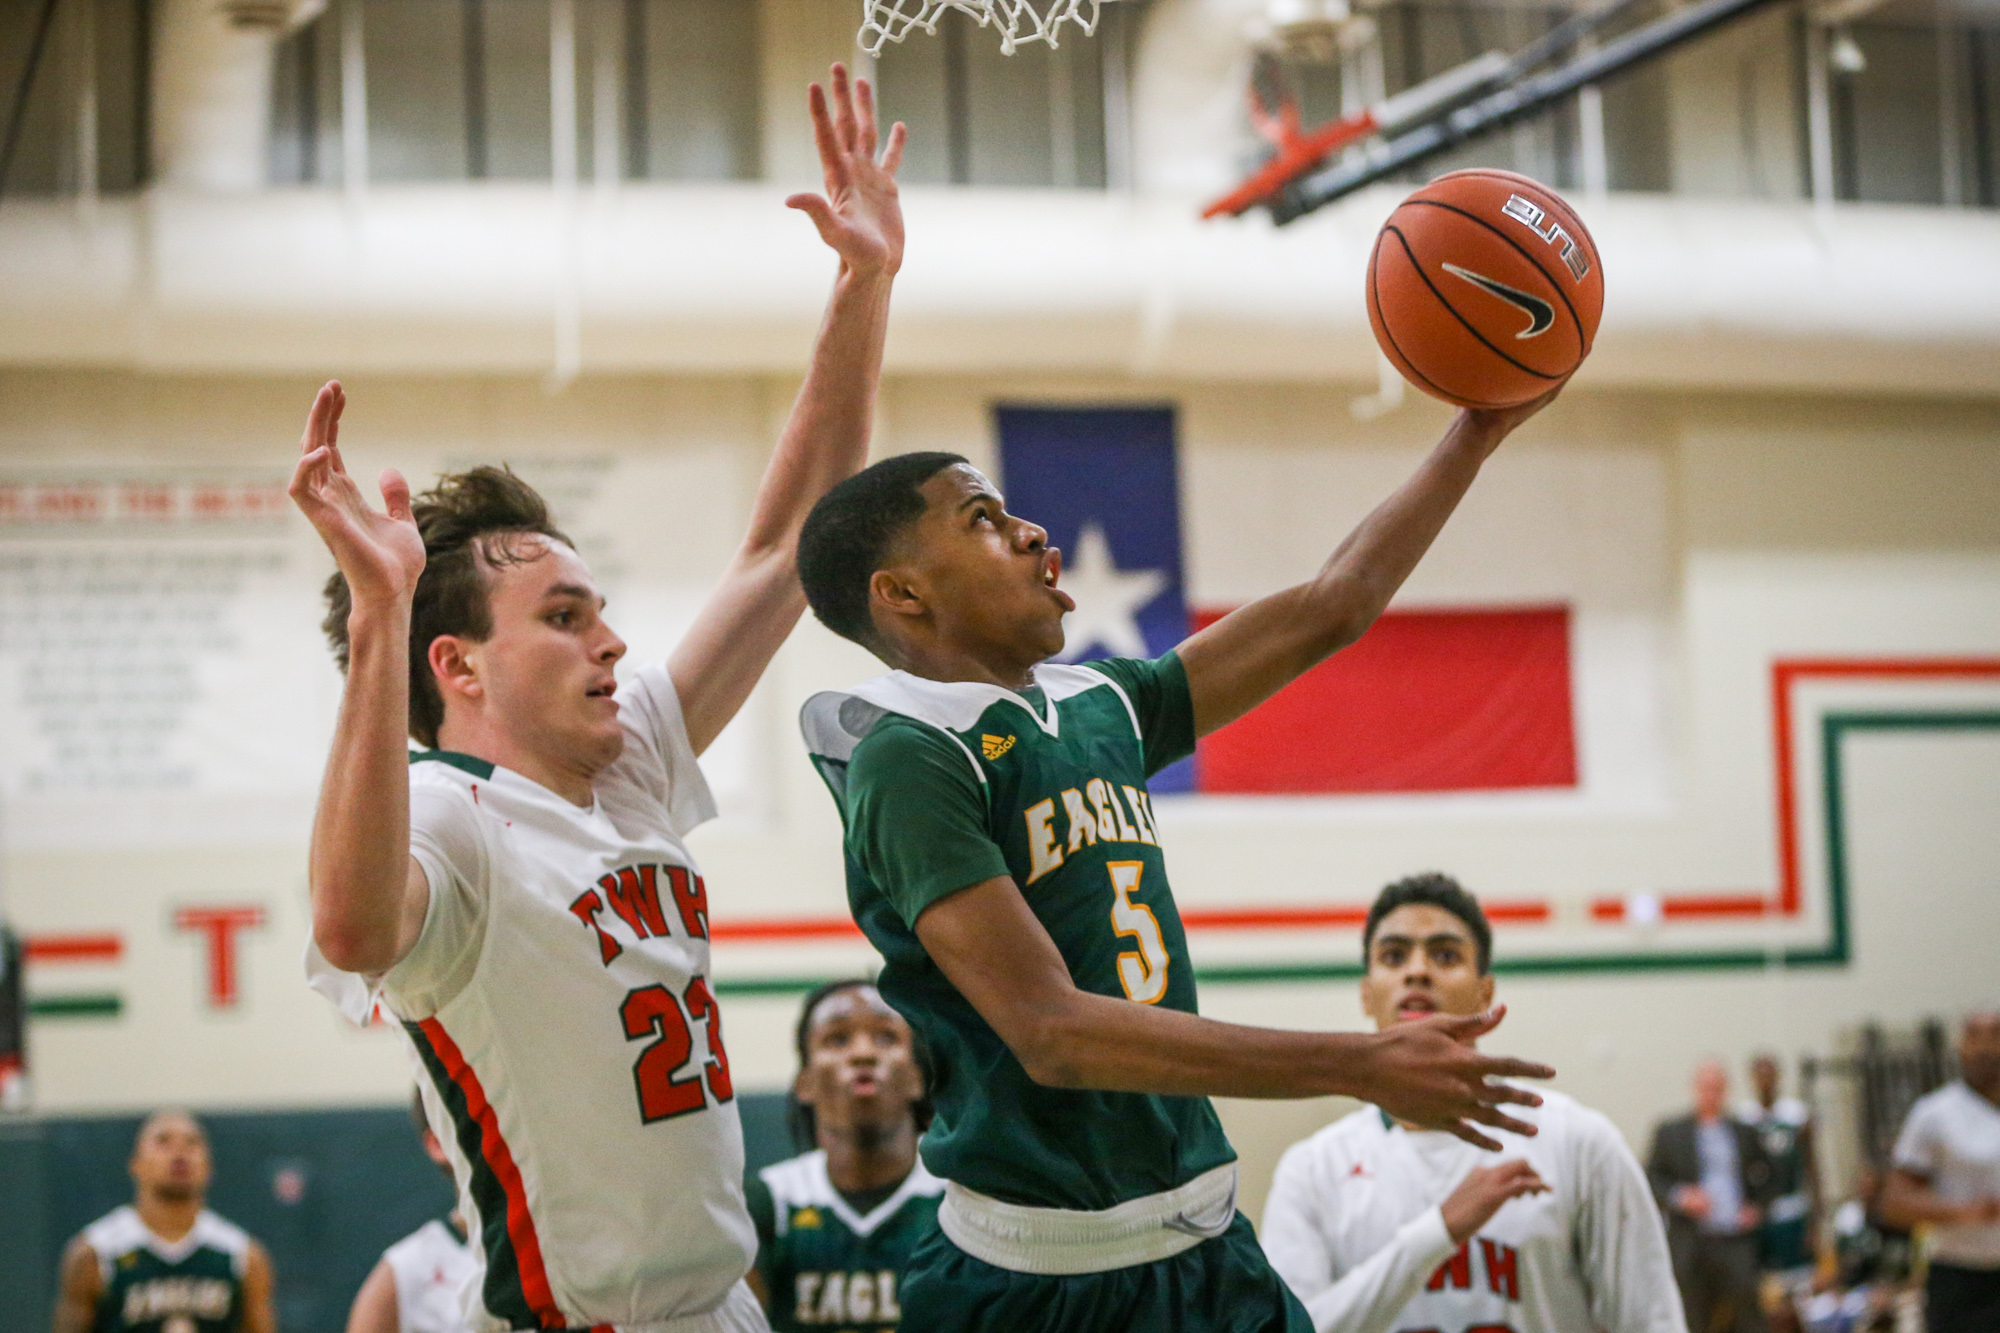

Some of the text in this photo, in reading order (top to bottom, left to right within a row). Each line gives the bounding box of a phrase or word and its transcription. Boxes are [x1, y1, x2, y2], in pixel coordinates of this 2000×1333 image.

[1501, 193, 1590, 283] ELITE
[569, 862, 711, 968] TWH
[1106, 860, 1170, 1005] 5
[618, 974, 734, 1126] 23
[795, 1270, 902, 1324] EAGL
[1425, 1236, 1519, 1303] WH
